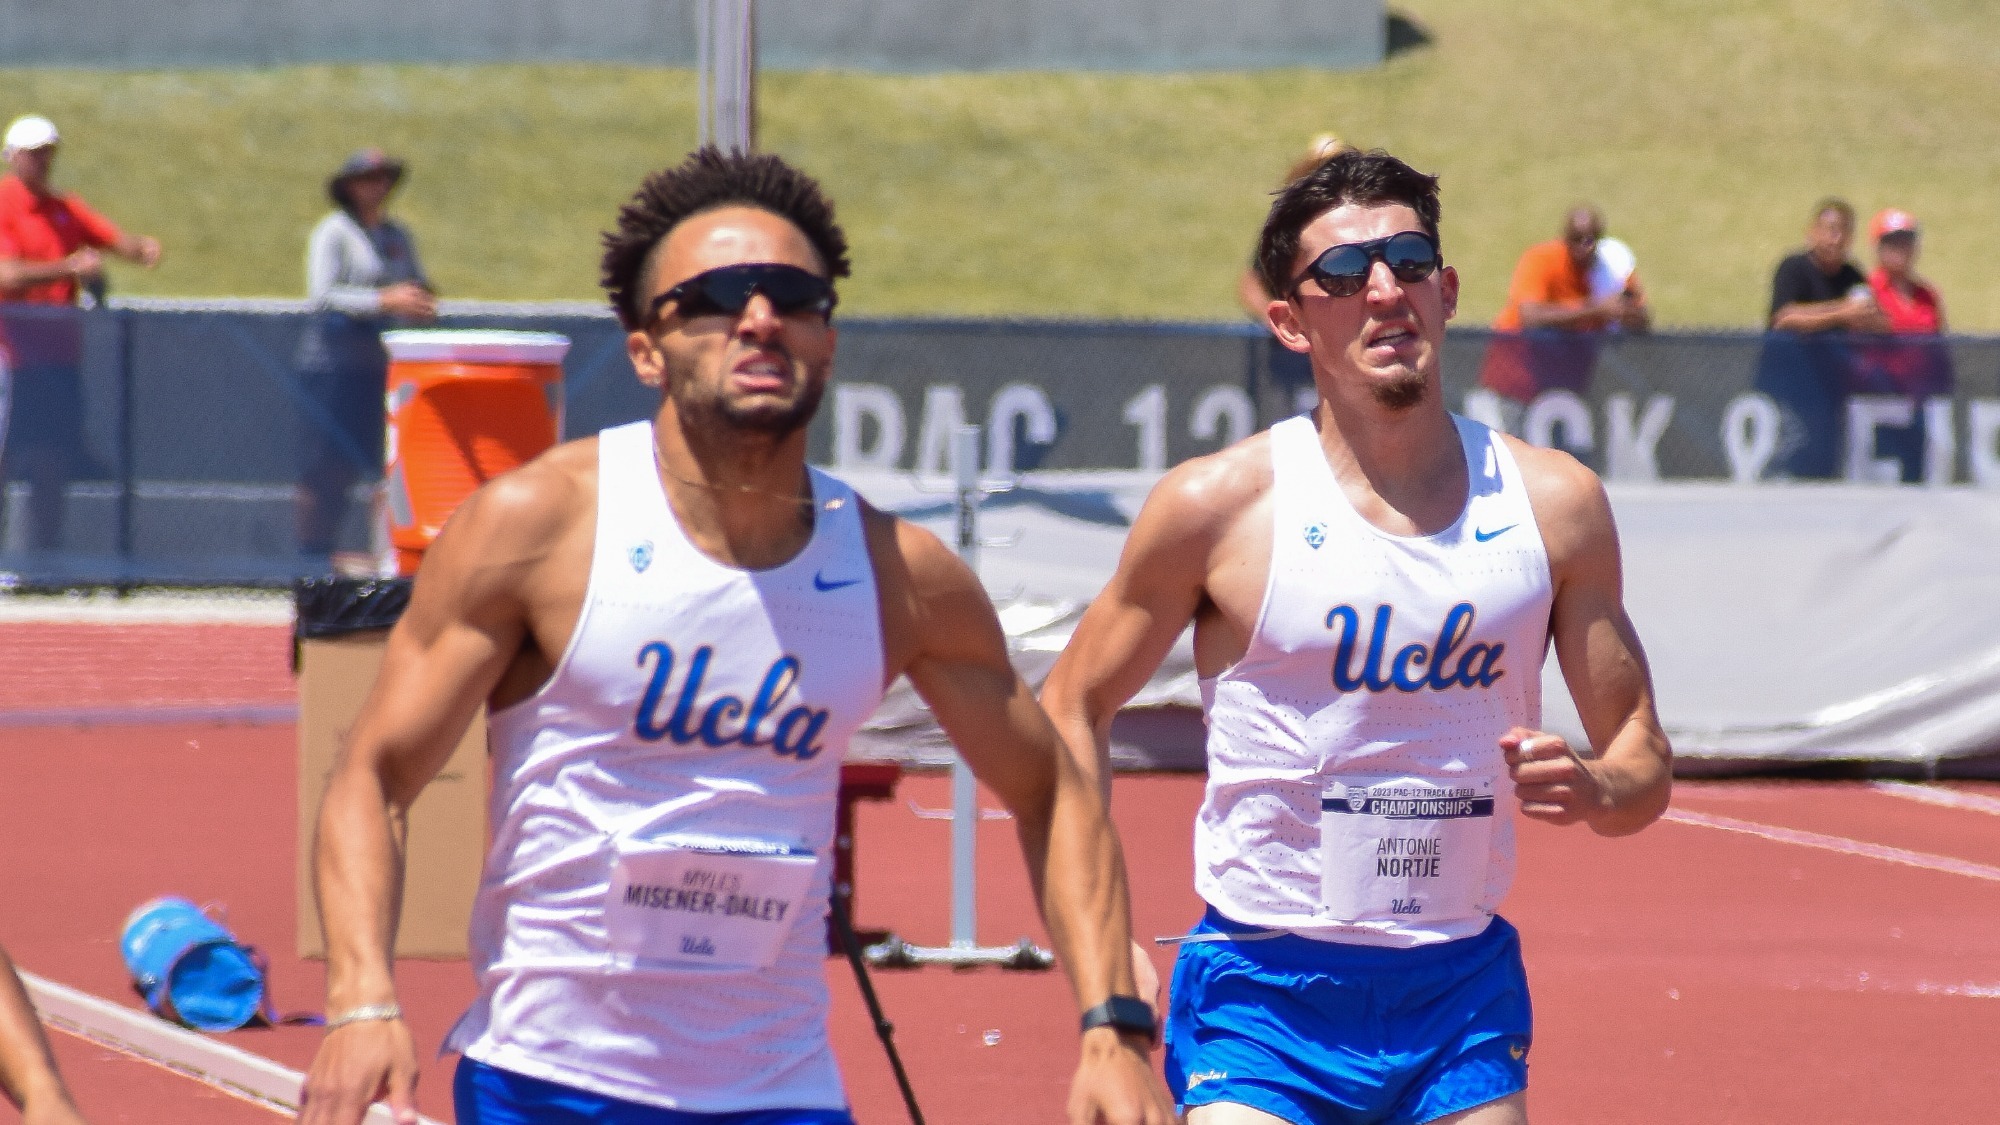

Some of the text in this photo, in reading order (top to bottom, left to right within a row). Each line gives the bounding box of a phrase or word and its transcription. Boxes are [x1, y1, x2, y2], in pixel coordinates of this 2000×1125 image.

[1372, 788, 1475, 797] 2023 PAC-12 TRACK & FIELD
[1371, 800, 1473, 815] CHAMPIONSHIPS
[1377, 838, 1442, 855] ANTONIE
[1377, 858, 1440, 877] NORTJE
[623, 884, 790, 922] MISENER-DALEY
